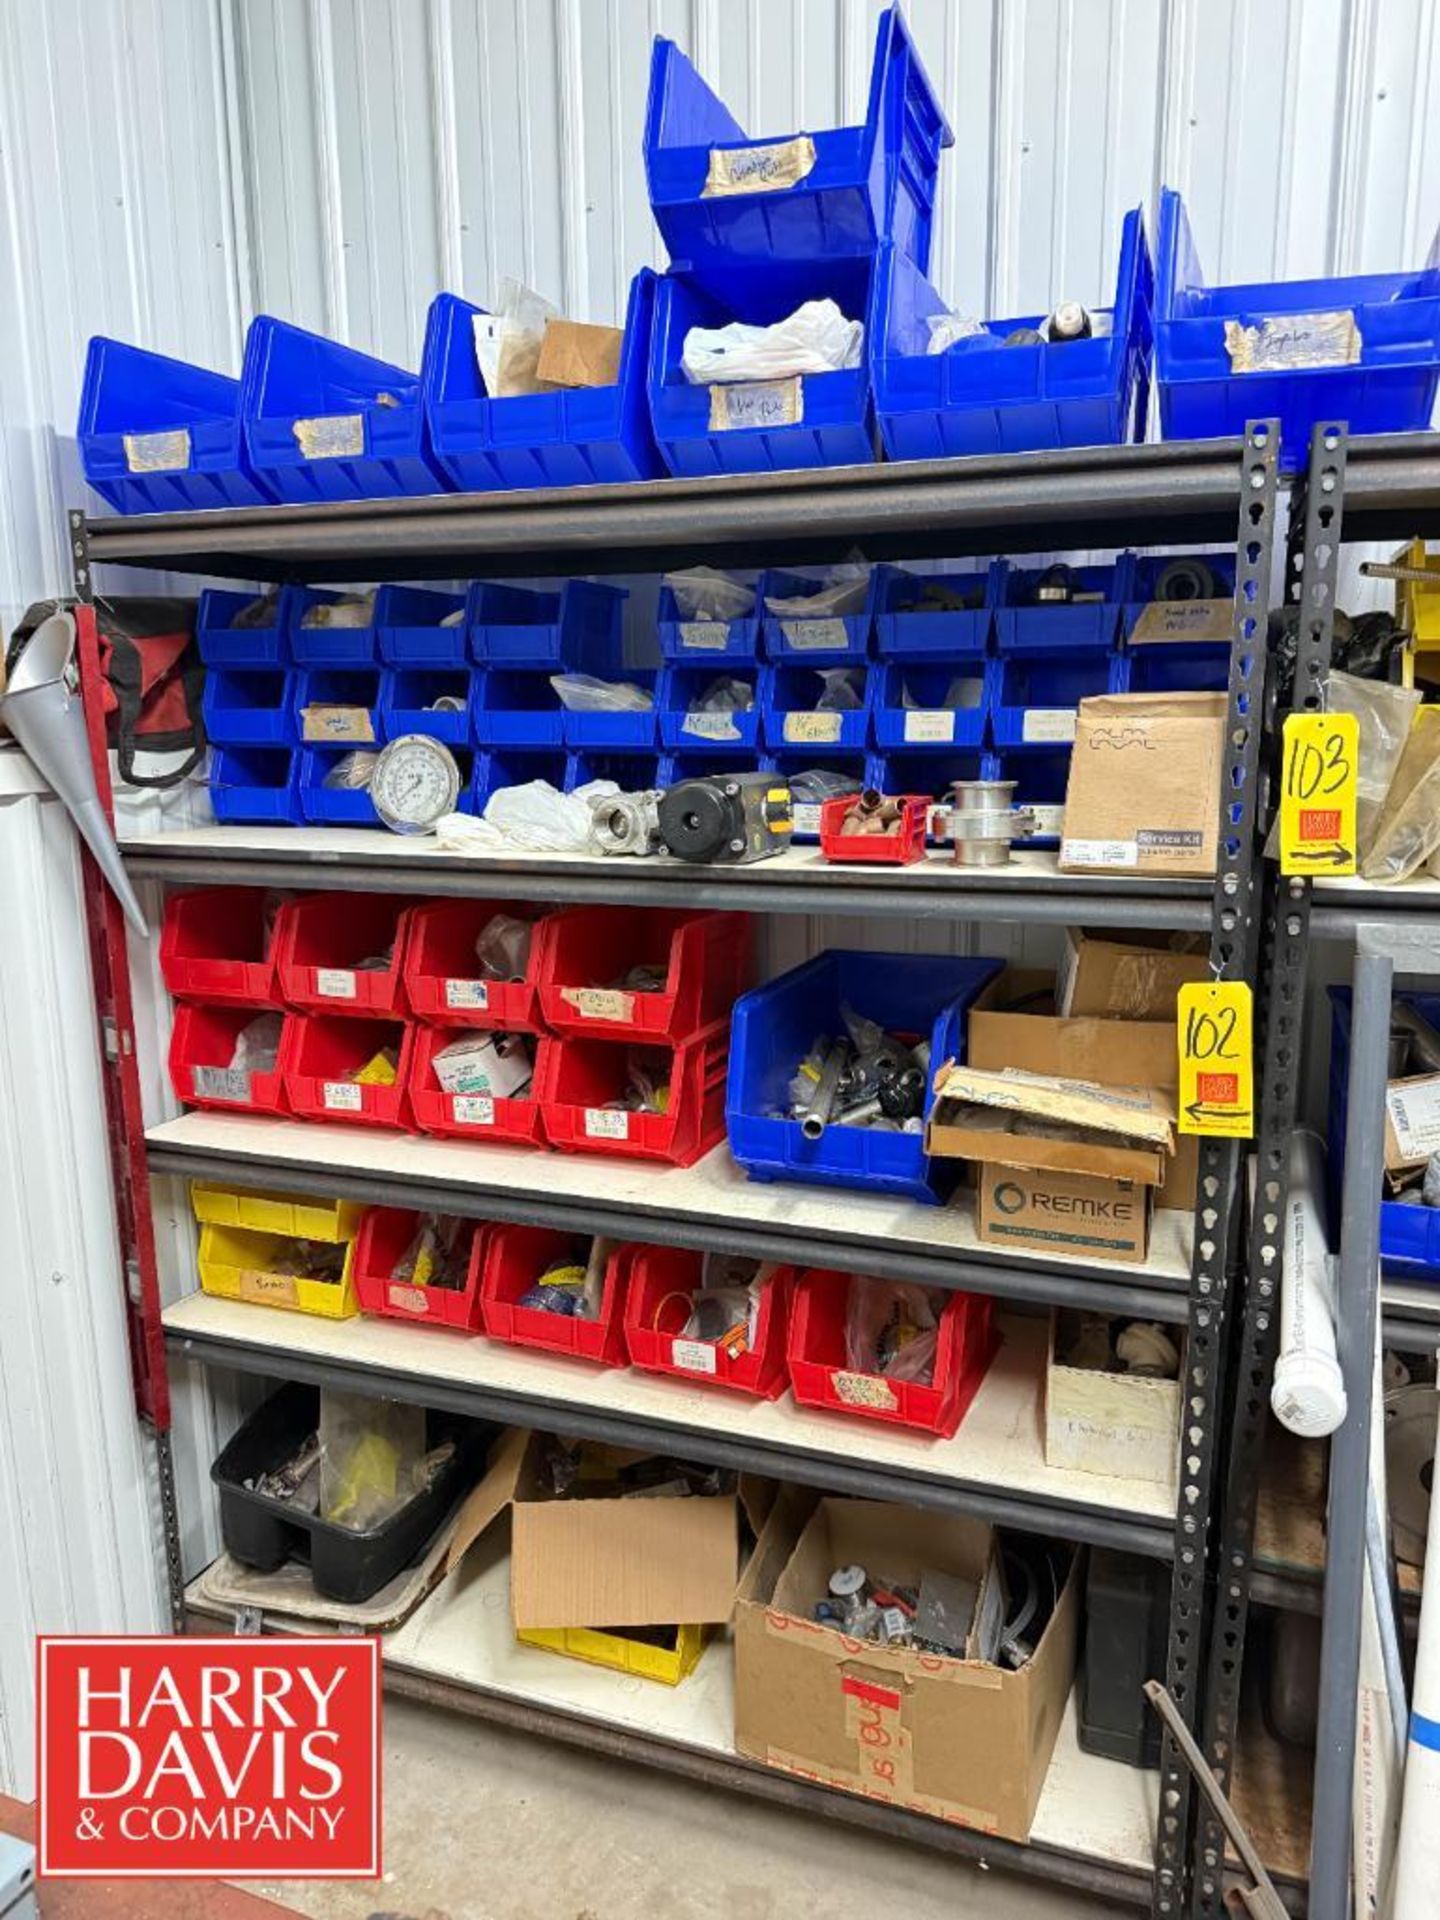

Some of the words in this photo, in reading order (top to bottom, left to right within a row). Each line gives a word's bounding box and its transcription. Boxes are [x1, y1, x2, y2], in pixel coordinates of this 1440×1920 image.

[1288, 734, 1350, 800] 103
[1183, 833, 1201, 845] Kit
[1185, 1006, 1241, 1060] 102
[1031, 1192, 1133, 1221] REMKE
